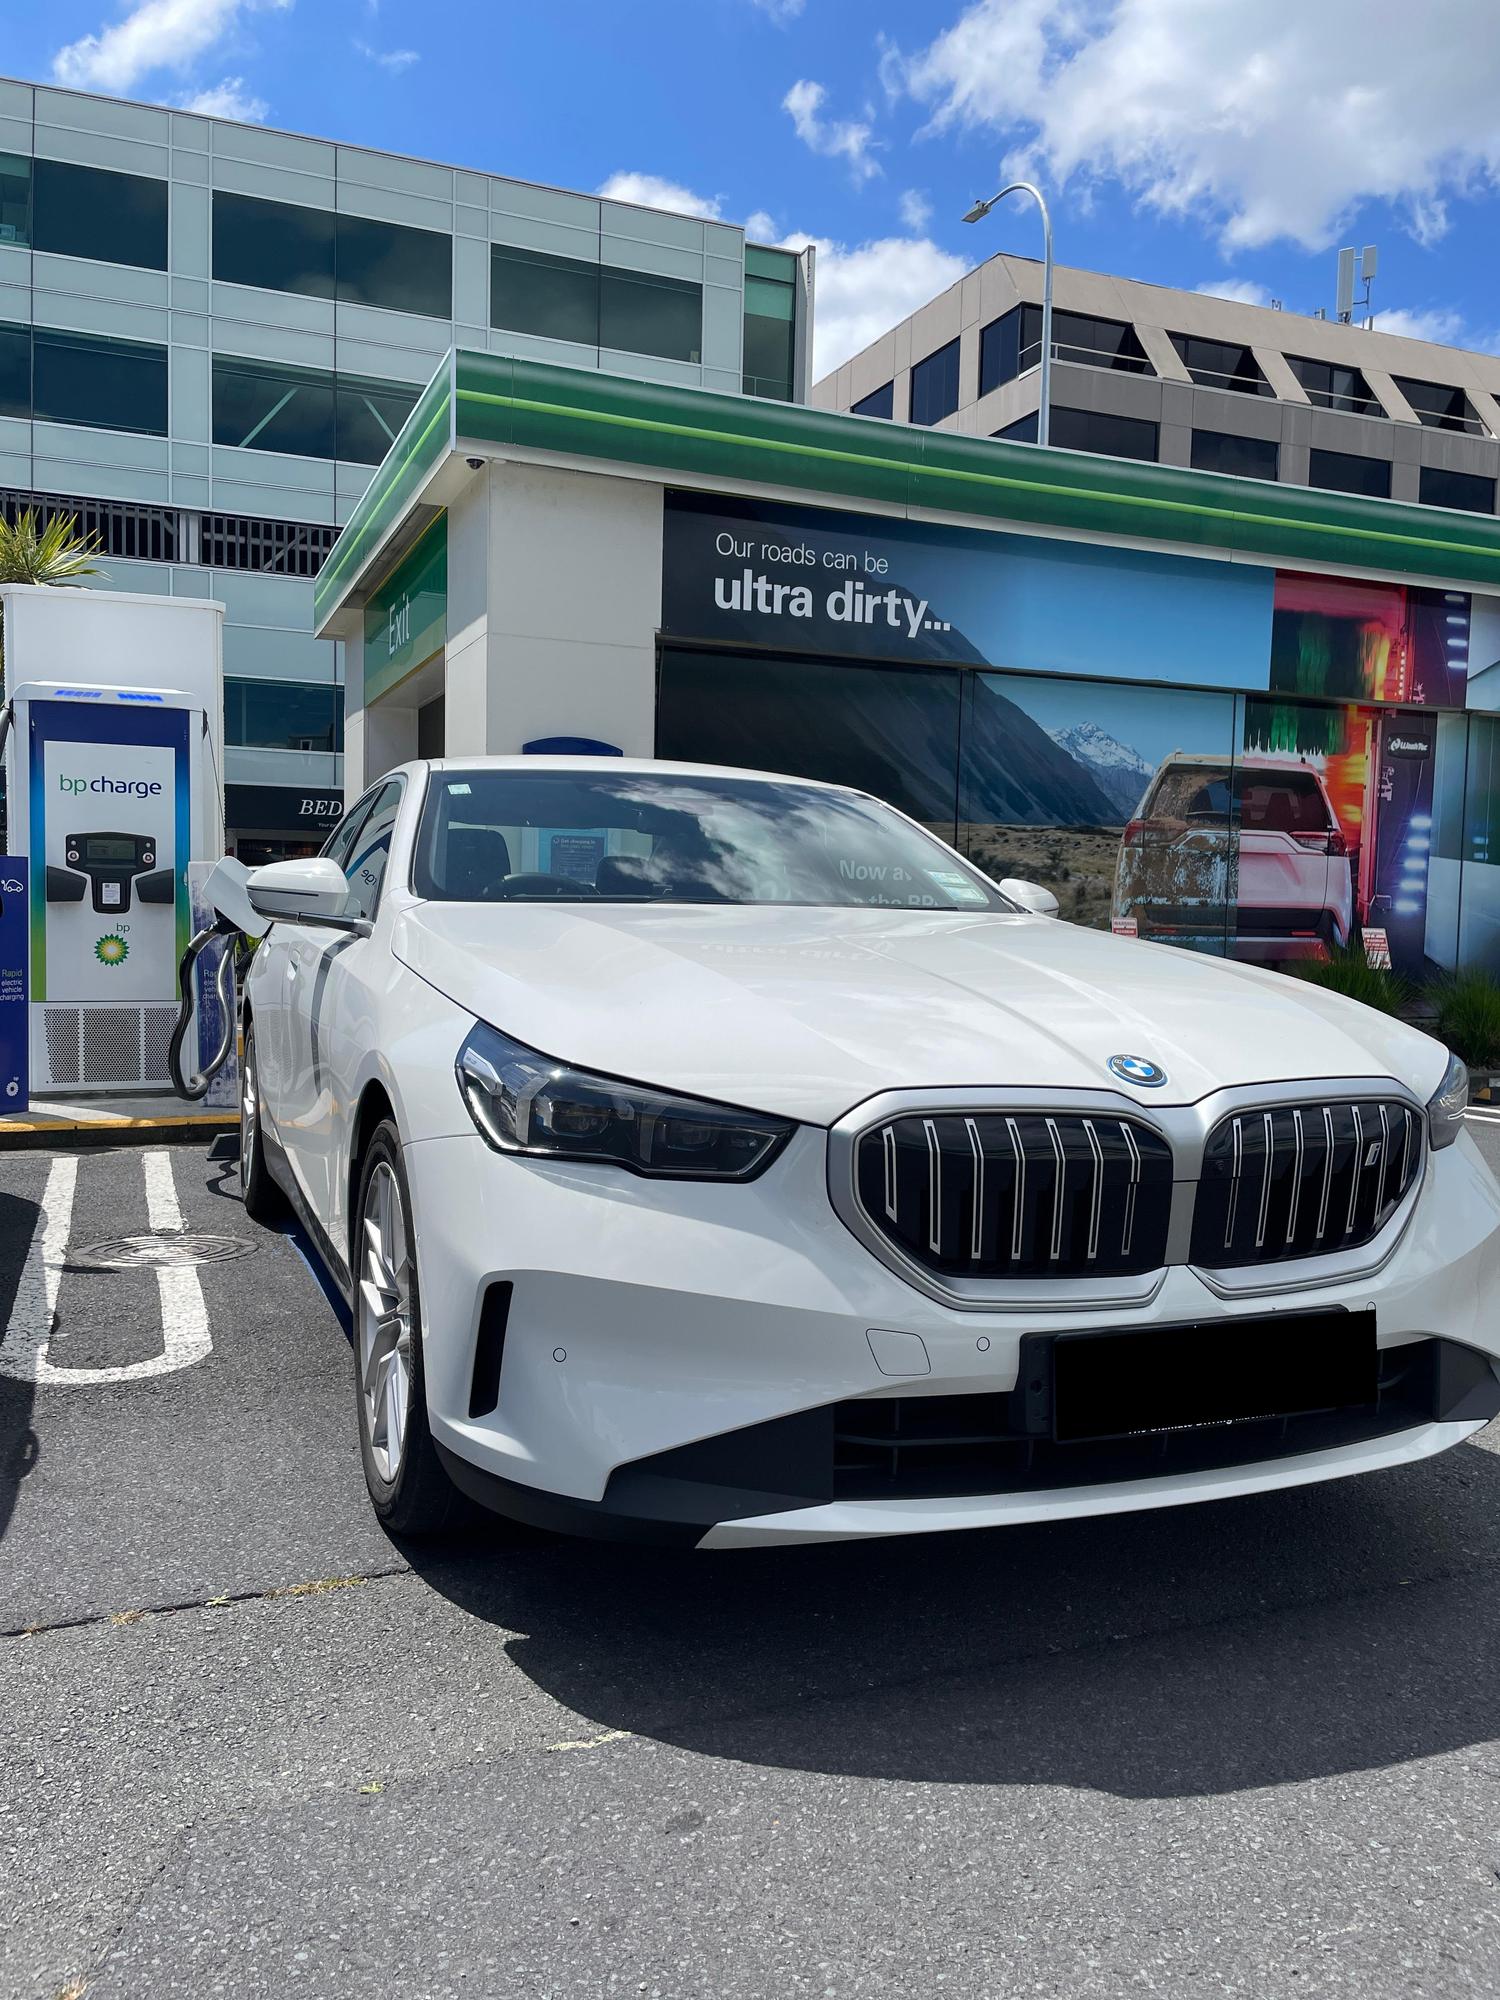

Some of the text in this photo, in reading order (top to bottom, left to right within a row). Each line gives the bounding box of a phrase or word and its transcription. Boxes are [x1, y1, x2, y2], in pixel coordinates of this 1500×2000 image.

[715, 532, 889, 574] Our roads can be
[714, 568, 951, 639] ultra dirty...
[388, 591, 410, 656] Exit
[60, 774, 162, 799] bp charge
[298, 799, 343, 816] BED
[839, 859, 888, 881] Now
[116, 923, 131, 934] bp
[2, 969, 23, 978] Rapid
